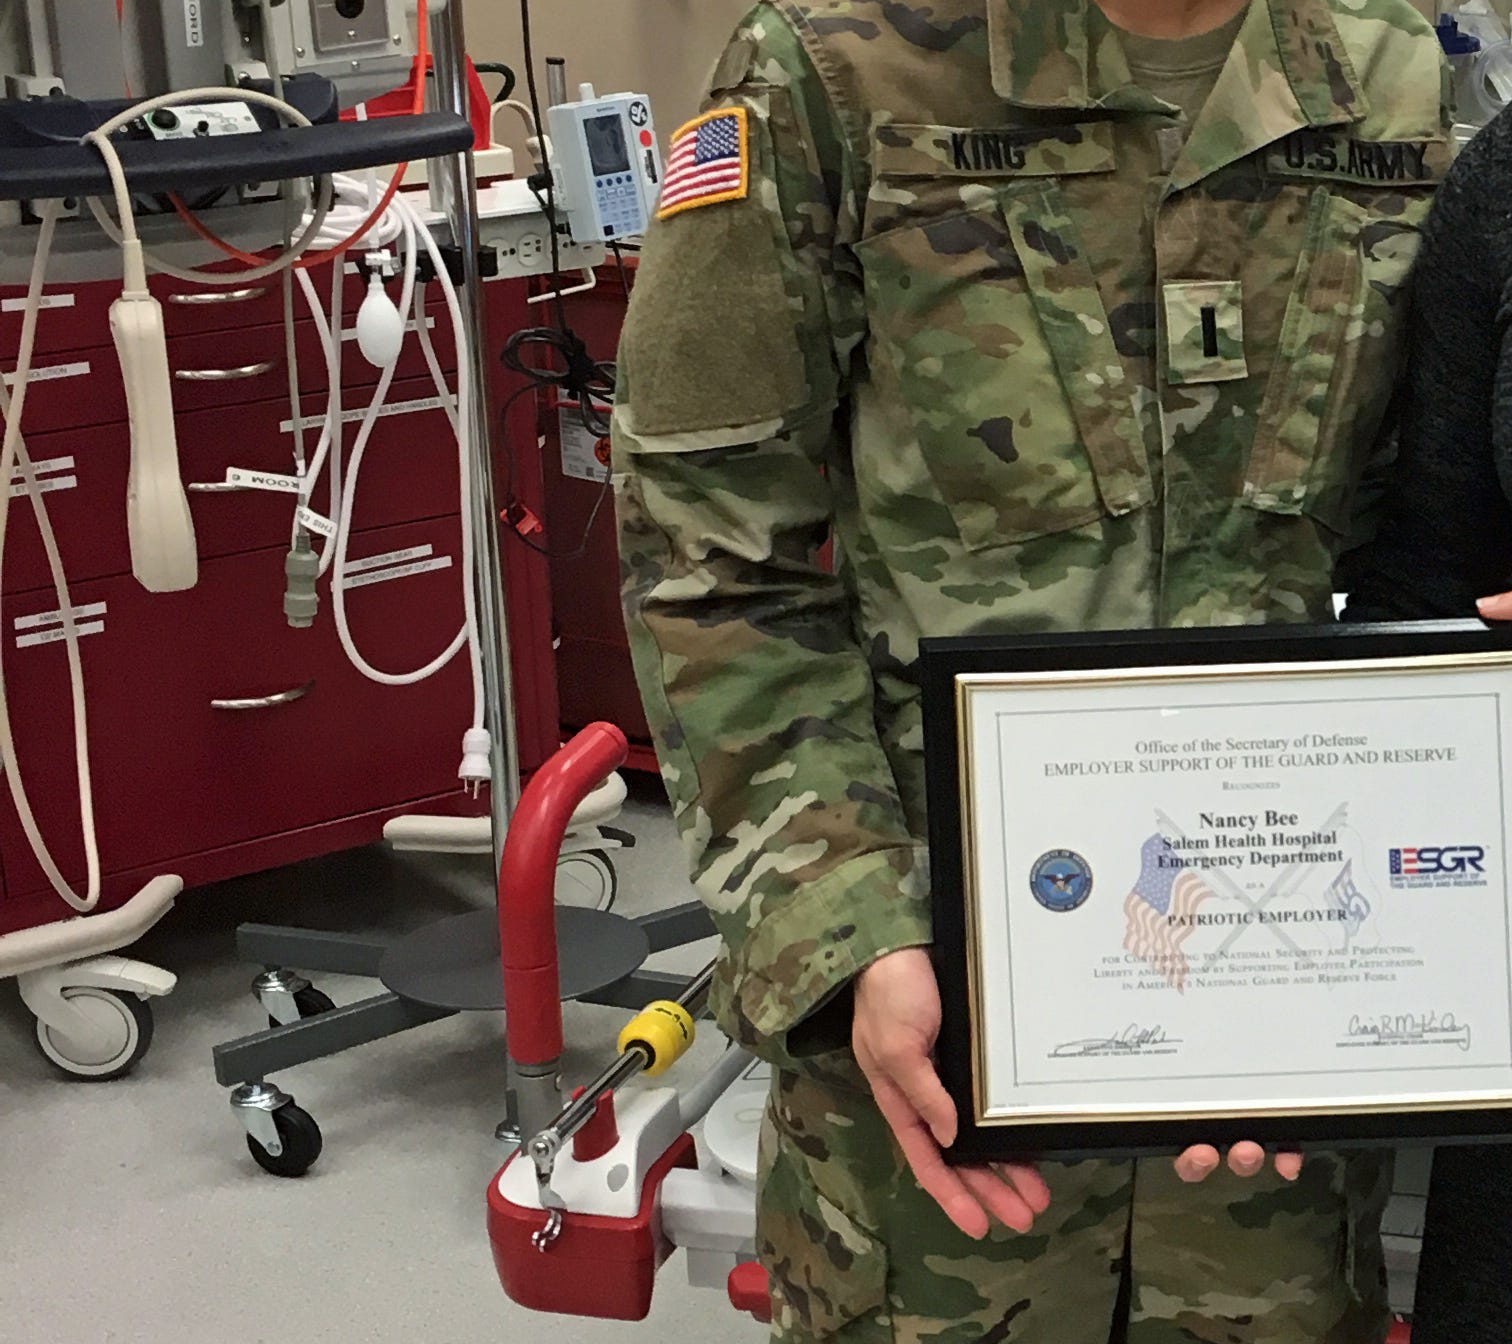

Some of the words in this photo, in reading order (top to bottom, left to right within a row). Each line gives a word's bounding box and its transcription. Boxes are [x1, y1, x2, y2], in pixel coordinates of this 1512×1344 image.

[952, 133, 1026, 170] KING
[1135, 740, 1178, 755] Office
[1182, 739, 1197, 752] of
[1200, 739, 1222, 752] the
[1226, 737, 1289, 752] Secretary
[1293, 735, 1310, 748] of
[1312, 734, 1368, 748] Defense
[1044, 761, 1134, 777] EMPLOYER
[1139, 758, 1212, 773] SUPPORT
[1216, 757, 1237, 769] OF
[1244, 755, 1275, 769] THE
[1278, 752, 1339, 768] GUARD
[1342, 751, 1379, 765] AND
[1383, 748, 1457, 763] RESERVE
[1199, 812, 1258, 831] Nancy
[1265, 810, 1298, 827] Bee
[1163, 836, 1209, 850] Salem
[1215, 834, 1266, 849] Health
[1272, 831, 1337, 849] Hospital
[1158, 854, 1244, 869] Emergency
[1250, 850, 1344, 868] Department
[1168, 913, 1253, 927] PATRIOTIC
[1259, 909, 1347, 924] EMPLOYER
